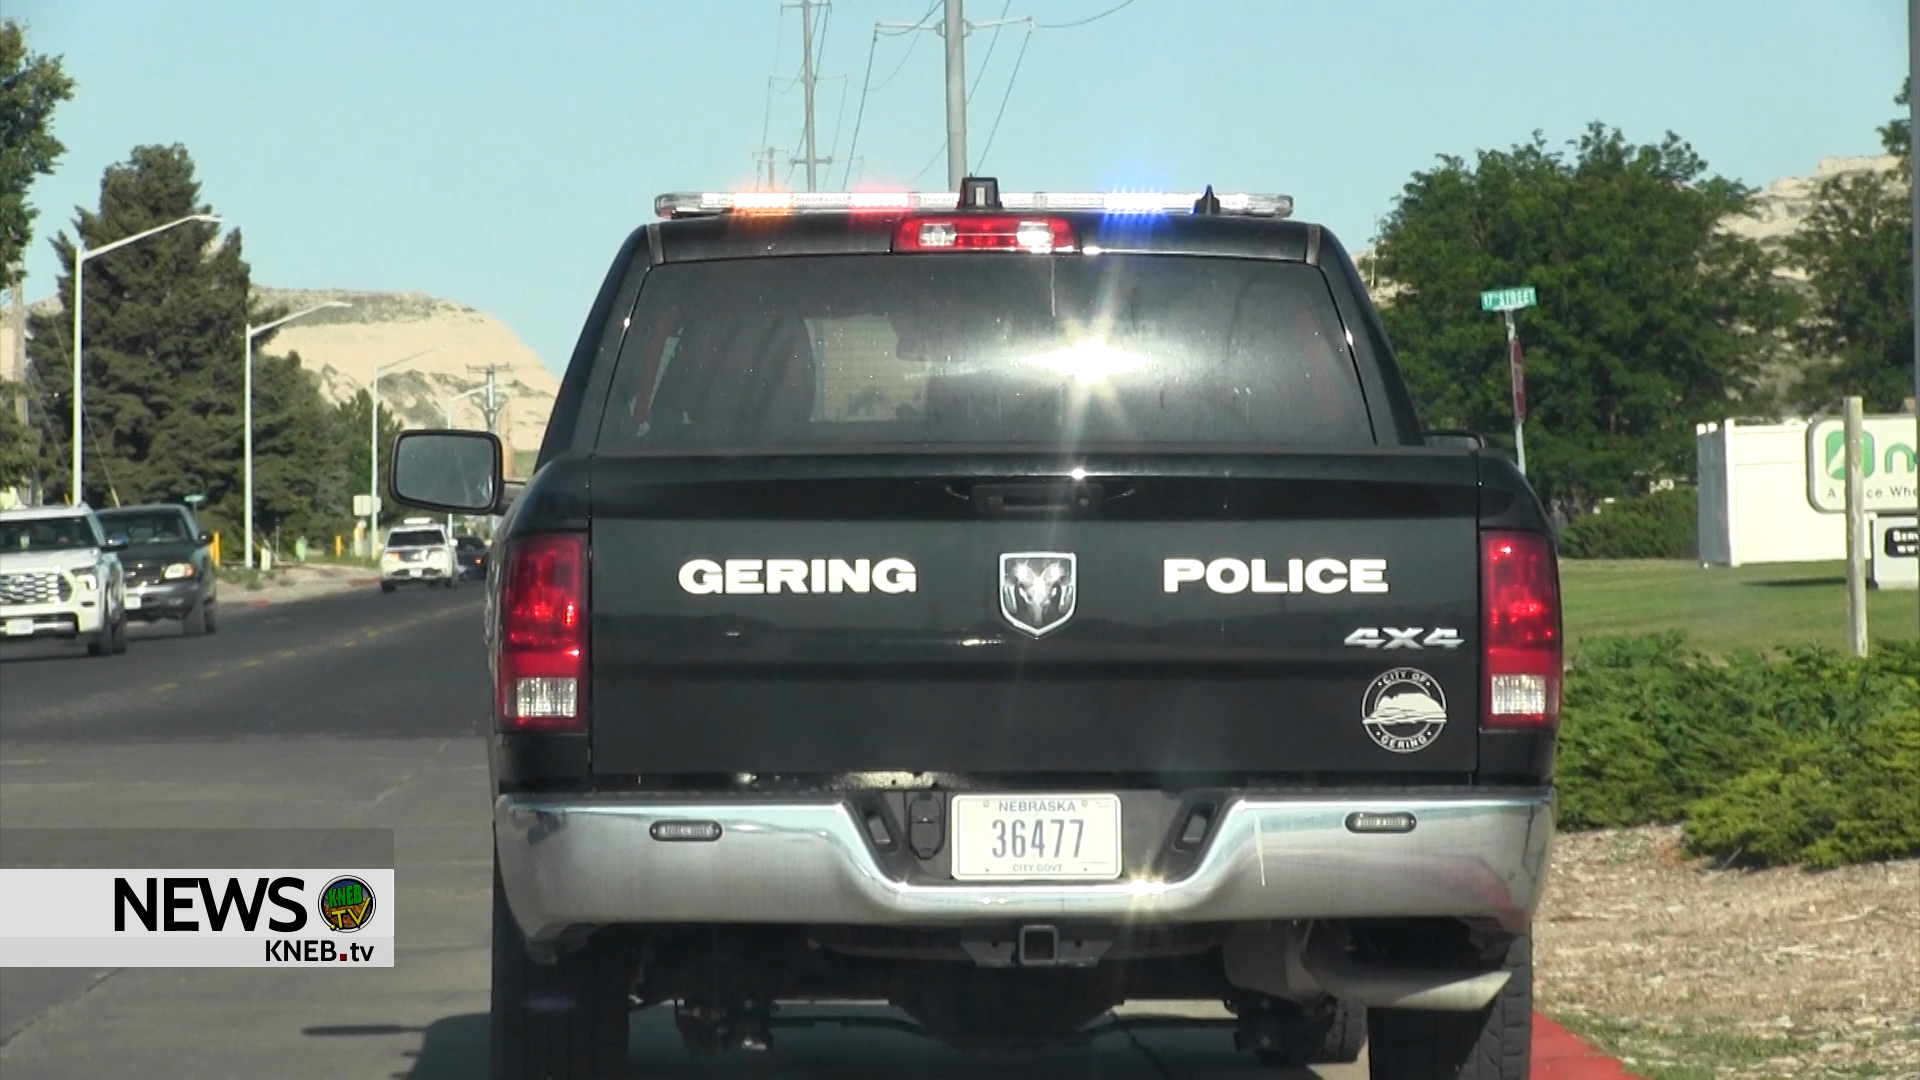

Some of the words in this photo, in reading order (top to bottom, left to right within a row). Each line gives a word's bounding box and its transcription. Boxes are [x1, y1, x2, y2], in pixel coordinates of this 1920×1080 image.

[1500, 290, 1535, 305] STREET
[678, 558, 917, 594] GERING
[1163, 558, 1389, 594] POLICE
[1383, 671, 1406, 684] CITY
[1412, 673, 1428, 682] OF
[1381, 735, 1427, 748] GERING
[1000, 801, 1076, 812] NEBRASKA
[992, 819, 1084, 858] 36477
[1013, 864, 1034, 872] CITY
[1037, 864, 1063, 872] GOVT
